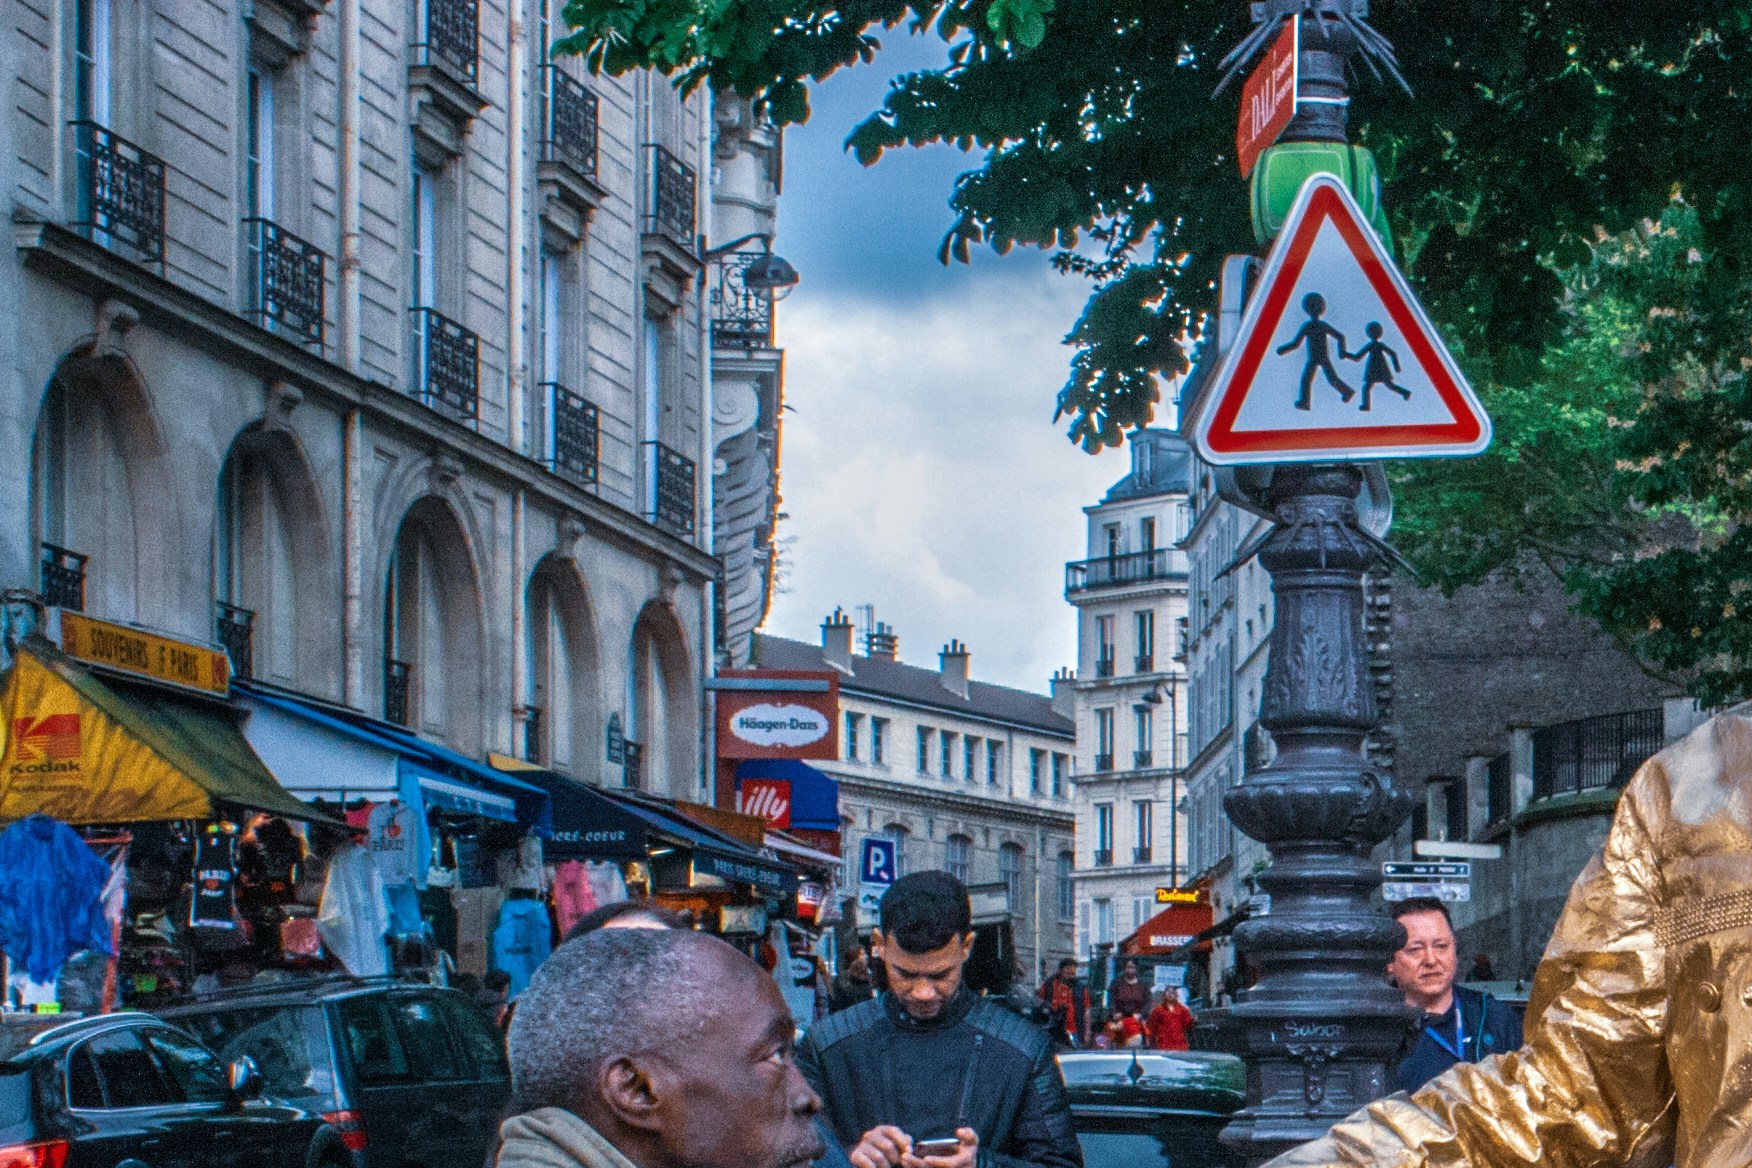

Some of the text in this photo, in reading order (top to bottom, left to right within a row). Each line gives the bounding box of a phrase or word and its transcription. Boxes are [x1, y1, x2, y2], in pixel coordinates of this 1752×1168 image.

[91, 627, 149, 669] SOUVENIRS
[169, 648, 199, 682] PARIS
[740, 717, 819, 733] Häagen-Dazs
[10, 760, 81, 774] Kodak
[744, 786, 788, 821] illy
[869, 846, 887, 877] P
[1149, 935, 1194, 946] BRASSER
